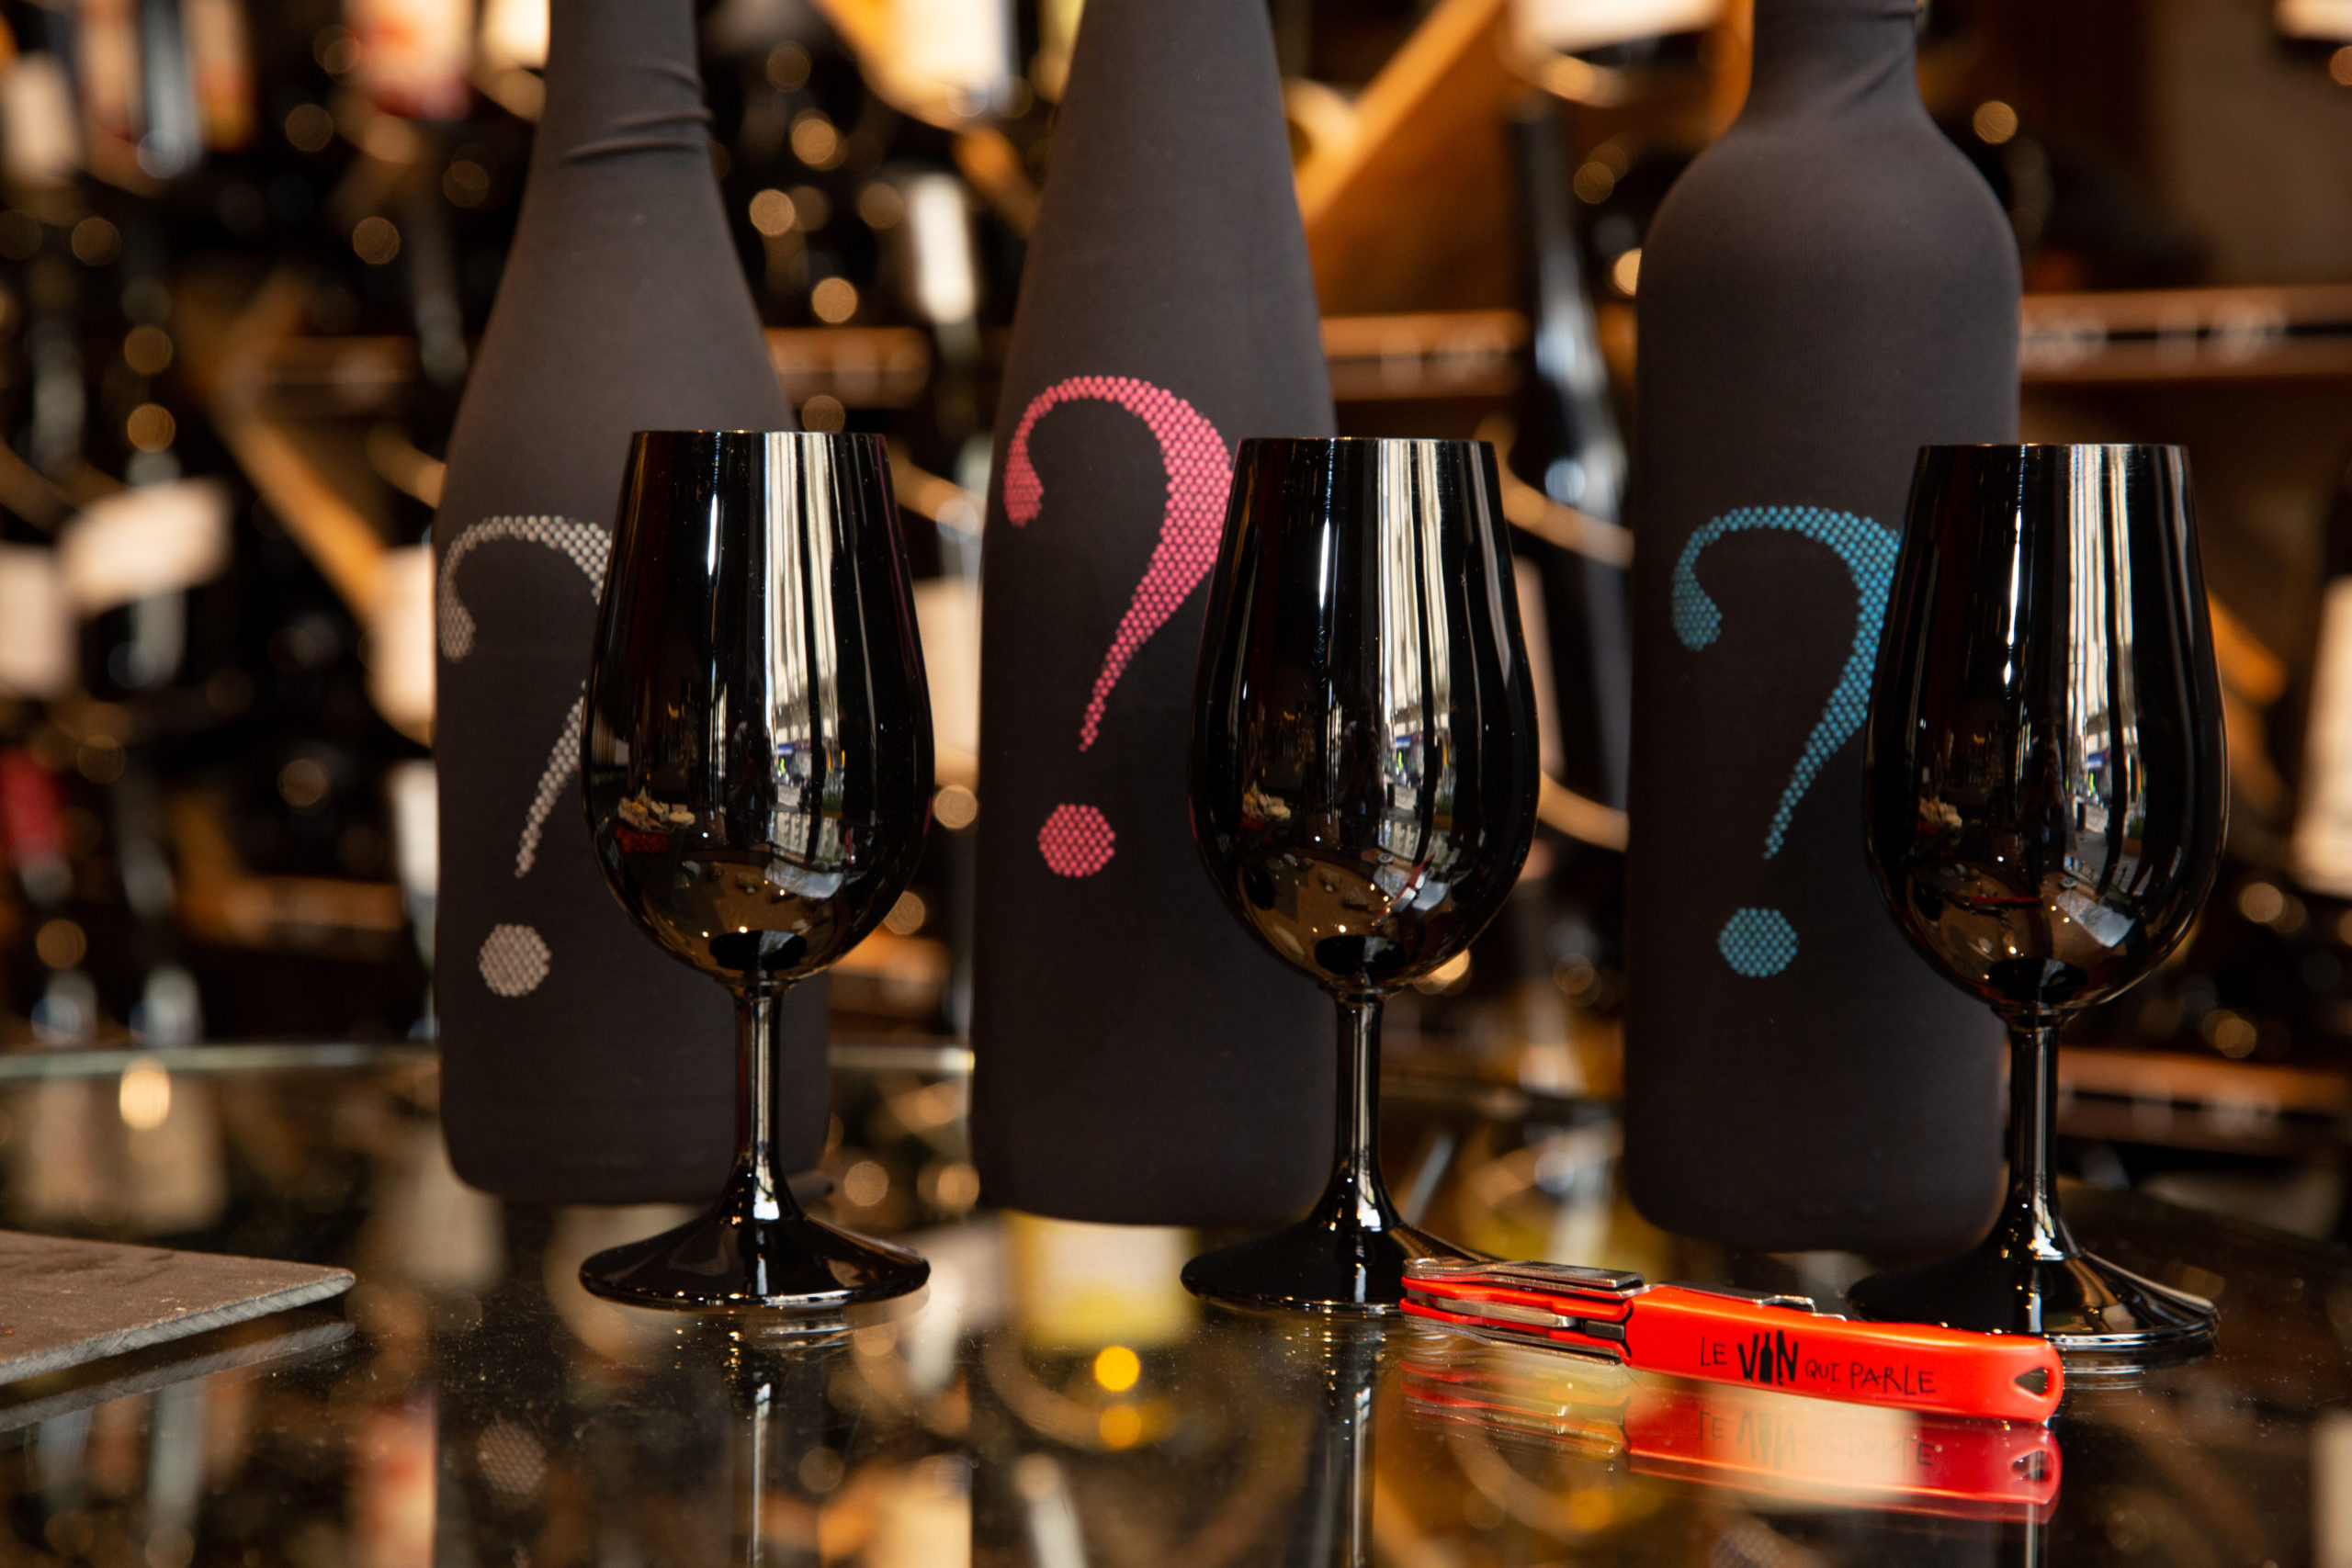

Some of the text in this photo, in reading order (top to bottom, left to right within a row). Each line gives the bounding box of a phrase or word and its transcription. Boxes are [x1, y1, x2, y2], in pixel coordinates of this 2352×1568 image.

[1700, 1329, 1936, 1396] LE VIN QUI PARLE
